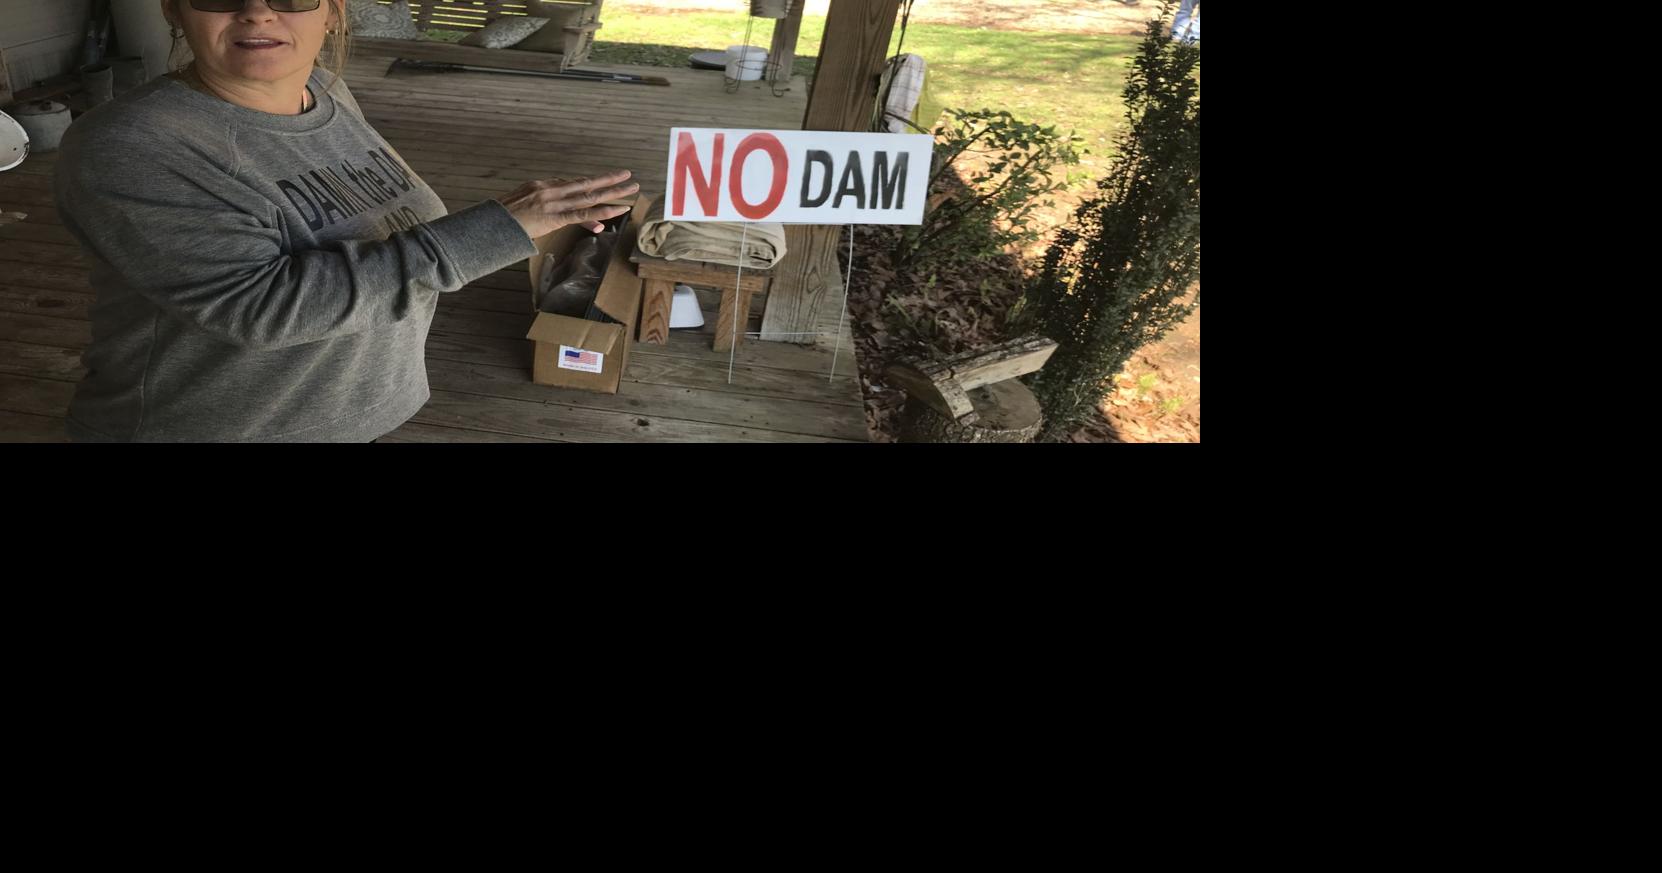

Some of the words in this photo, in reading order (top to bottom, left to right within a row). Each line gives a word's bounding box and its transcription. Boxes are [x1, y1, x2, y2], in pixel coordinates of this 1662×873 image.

[341, 160, 399, 205] the
[672, 131, 789, 219] NO
[799, 149, 909, 210] DAM
